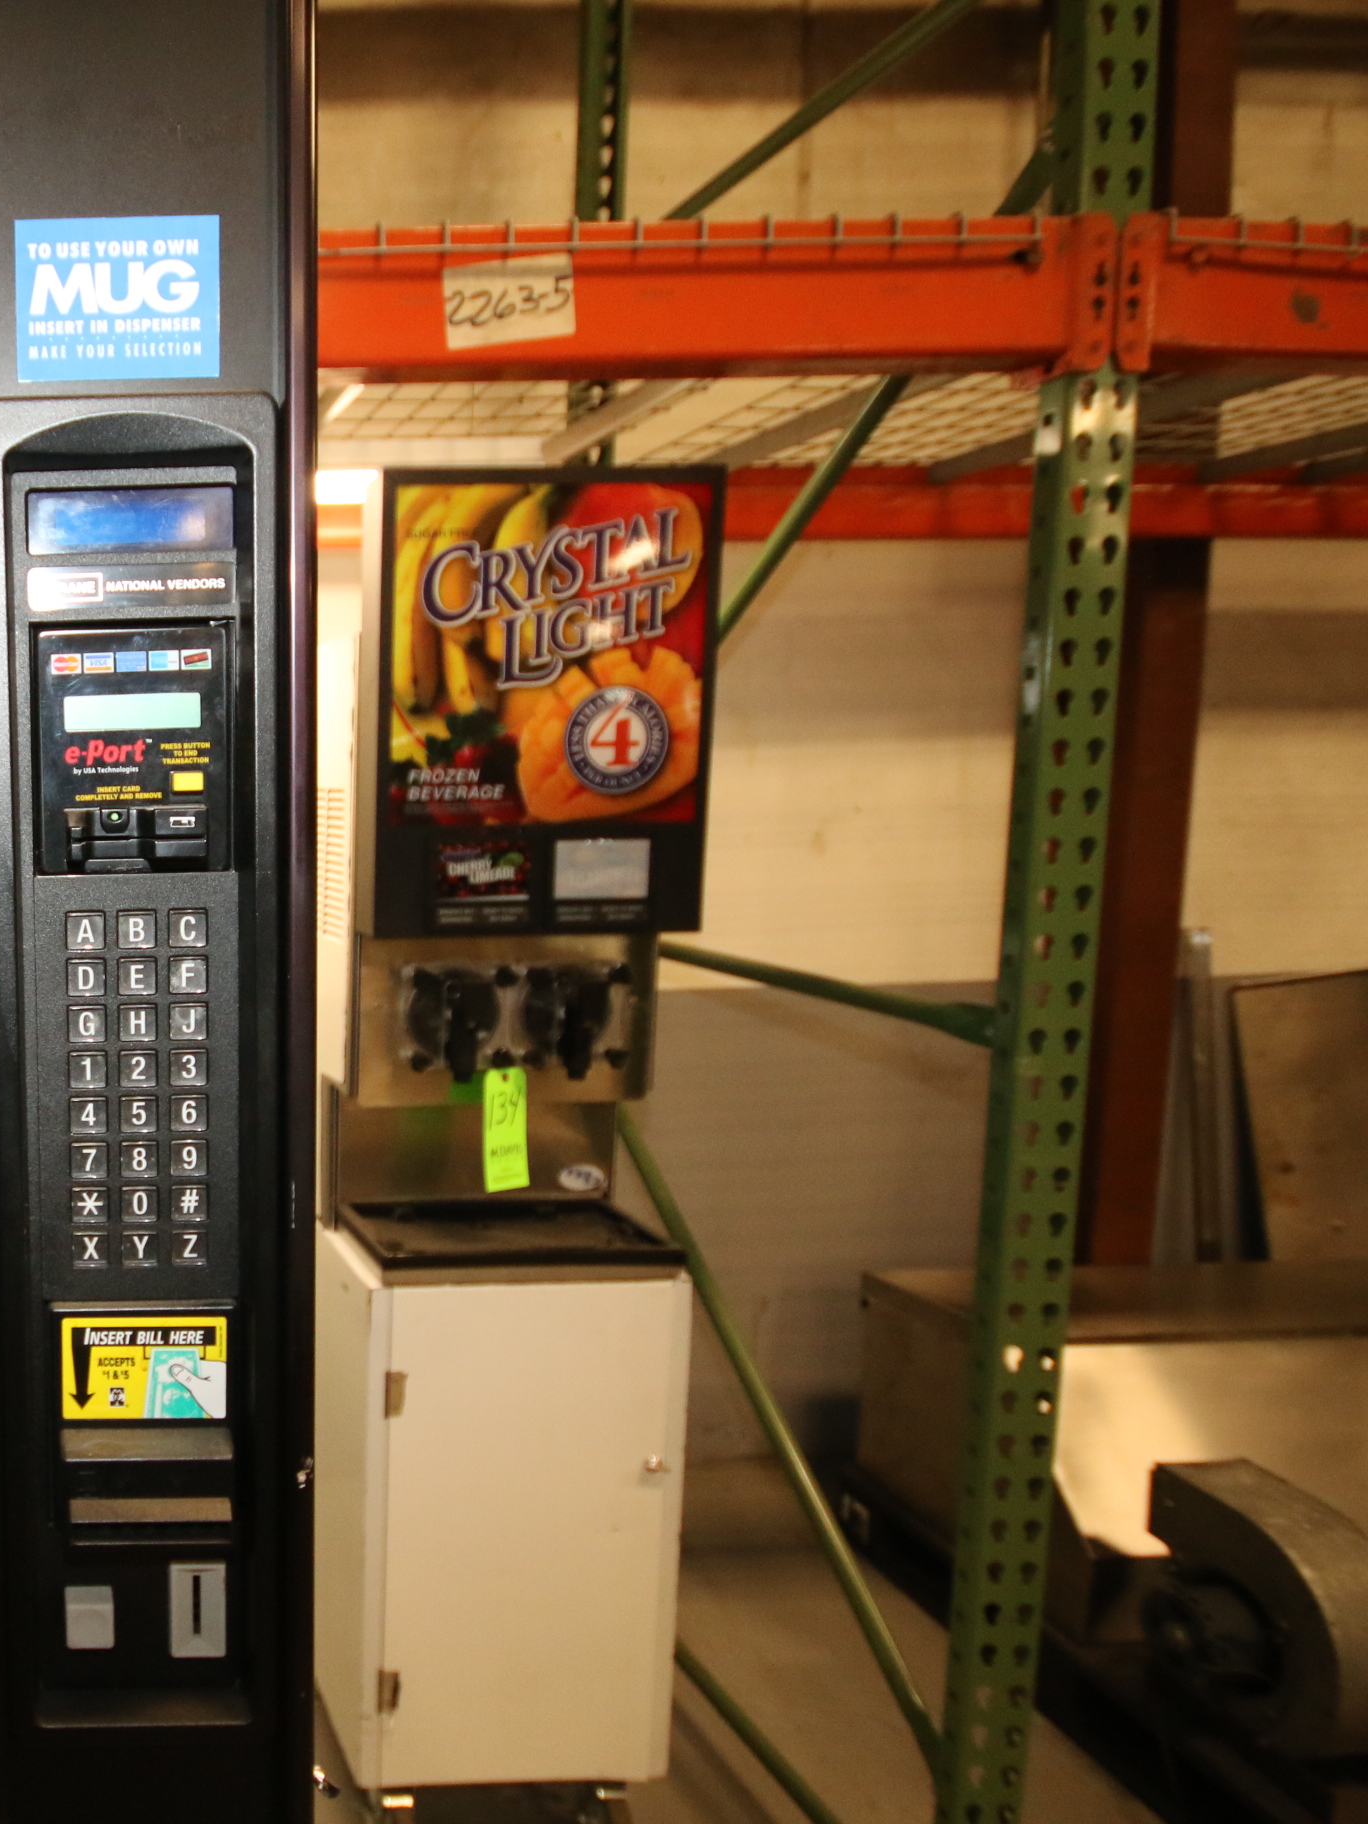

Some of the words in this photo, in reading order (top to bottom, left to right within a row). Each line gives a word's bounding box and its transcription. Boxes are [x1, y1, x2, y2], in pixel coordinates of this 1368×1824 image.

[28, 243, 51, 259] TO
[56, 241, 90, 258] USE
[95, 240, 148, 257] YOUR
[153, 239, 199, 255] OWN
[30, 259, 200, 315] MUG
[447, 275, 573, 326] 2263-5
[29, 320, 84, 335] INSERT
[90, 319, 108, 333] IN
[115, 317, 201, 333] DISPENSER
[29, 345, 66, 359] MAKE
[77, 344, 114, 359] YOUR
[125, 342, 201, 357] SELECTION
[422, 507, 691, 627] CRYSTAL
[106, 580, 165, 592] NATIONAL
[167, 578, 225, 590] VENDORS
[497, 577, 675, 690] LIGHT
[90, 659, 108, 667] VISA
[590, 696, 640, 767] 4
[64, 738, 146, 766] e-Port
[97, 766, 139, 775] Technologies
[407, 768, 481, 783] FROZEN
[408, 784, 505, 801] BEVERAGE
[77, 919, 95, 943] A
[129, 918, 145, 942] B
[179, 916, 197, 941] C
[78, 966, 94, 990] D
[130, 965, 144, 989] E
[181, 963, 195, 988] F
[79, 1012, 95, 1036] G
[130, 1011, 147, 1035] H
[182, 1009, 196, 1034] J
[81, 1059, 92, 1081] 1
[131, 1057, 146, 1080] 2
[181, 1055, 197, 1079] 3
[81, 1104, 96, 1126] 4
[132, 1101, 147, 1125] 5
[181, 1100, 197, 1125] 6
[489, 1087, 523, 1131] 134
[81, 1148, 97, 1171] 7
[133, 1147, 147, 1171] 8
[182, 1145, 198, 1170] 9
[133, 1192, 148, 1214] 0
[181, 1189, 199, 1213] #
[83, 1237, 99, 1259] X
[133, 1236, 149, 1259] Y
[183, 1234, 198, 1258] Z
[84, 1327, 132, 1345] INSERT
[136, 1331, 164, 1344] BILL
[169, 1331, 204, 1344] HERE
[98, 1358, 135, 1367] ACCEPTS
